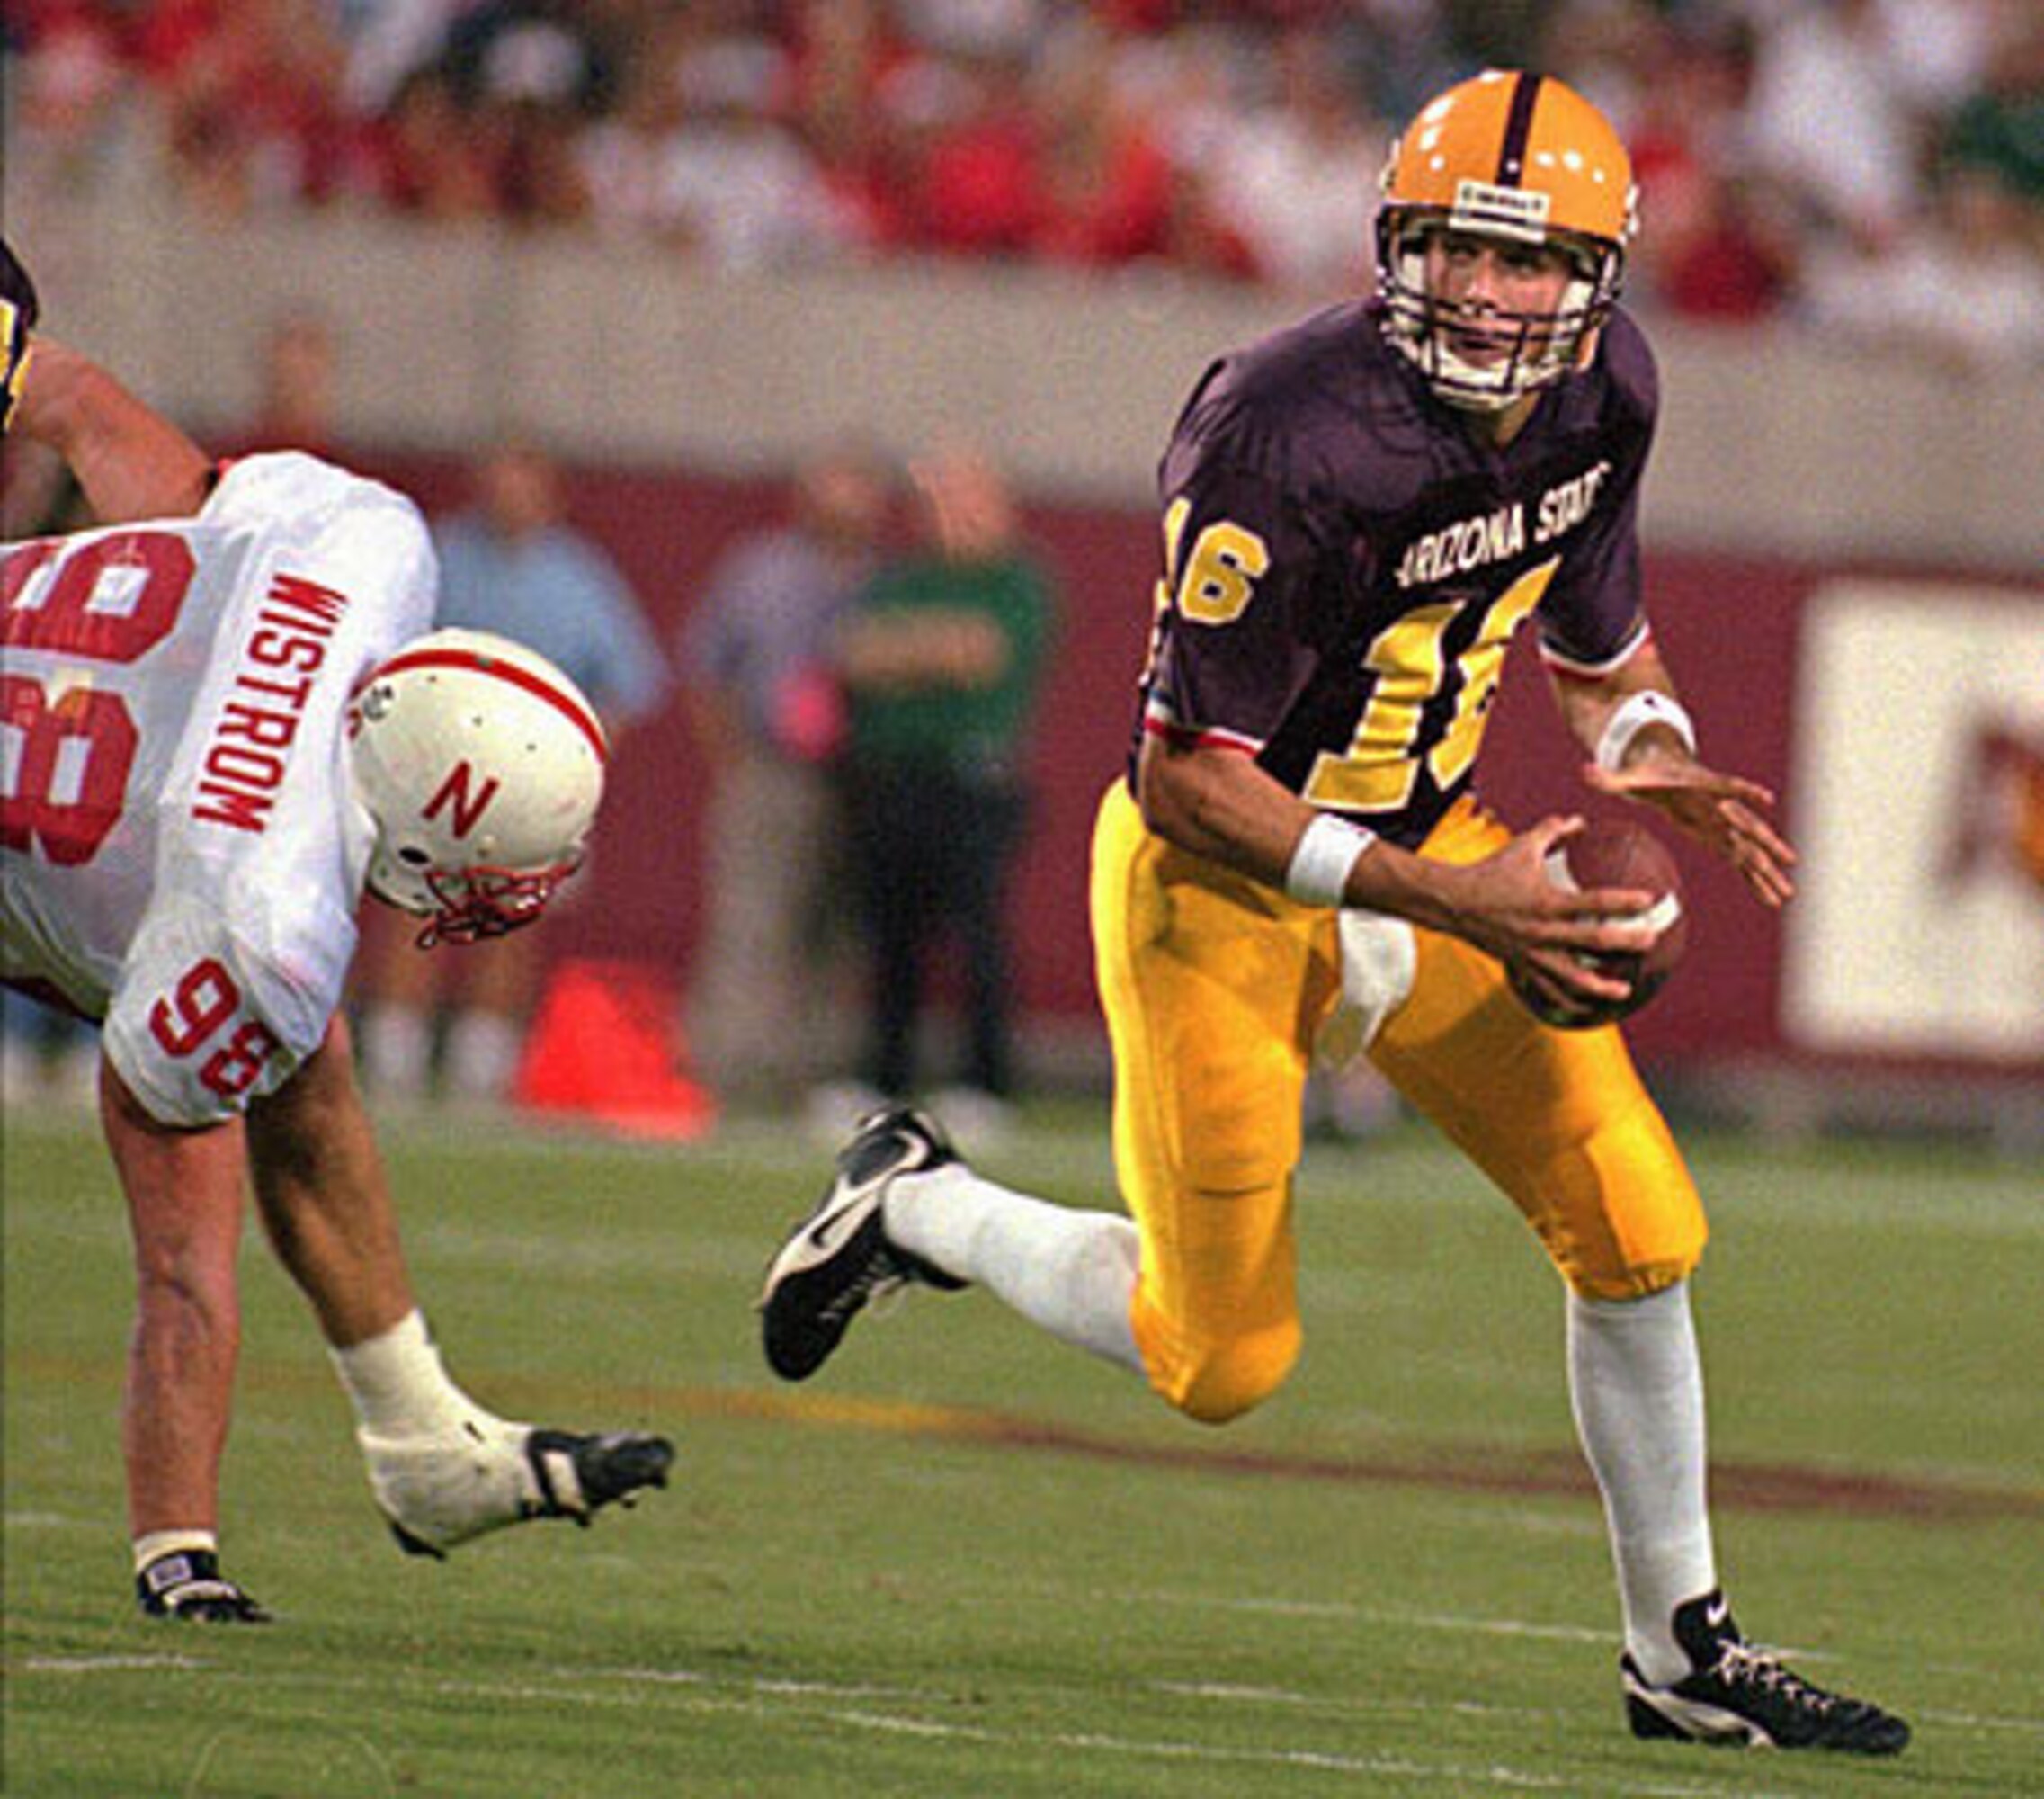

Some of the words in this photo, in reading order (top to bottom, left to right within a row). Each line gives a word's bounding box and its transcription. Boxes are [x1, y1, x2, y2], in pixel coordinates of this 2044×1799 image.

[1156, 497, 1271, 627] 16
[191, 572, 351, 834] WISTROM
[421, 760, 500, 838] N
[148, 956, 282, 1096] 98
